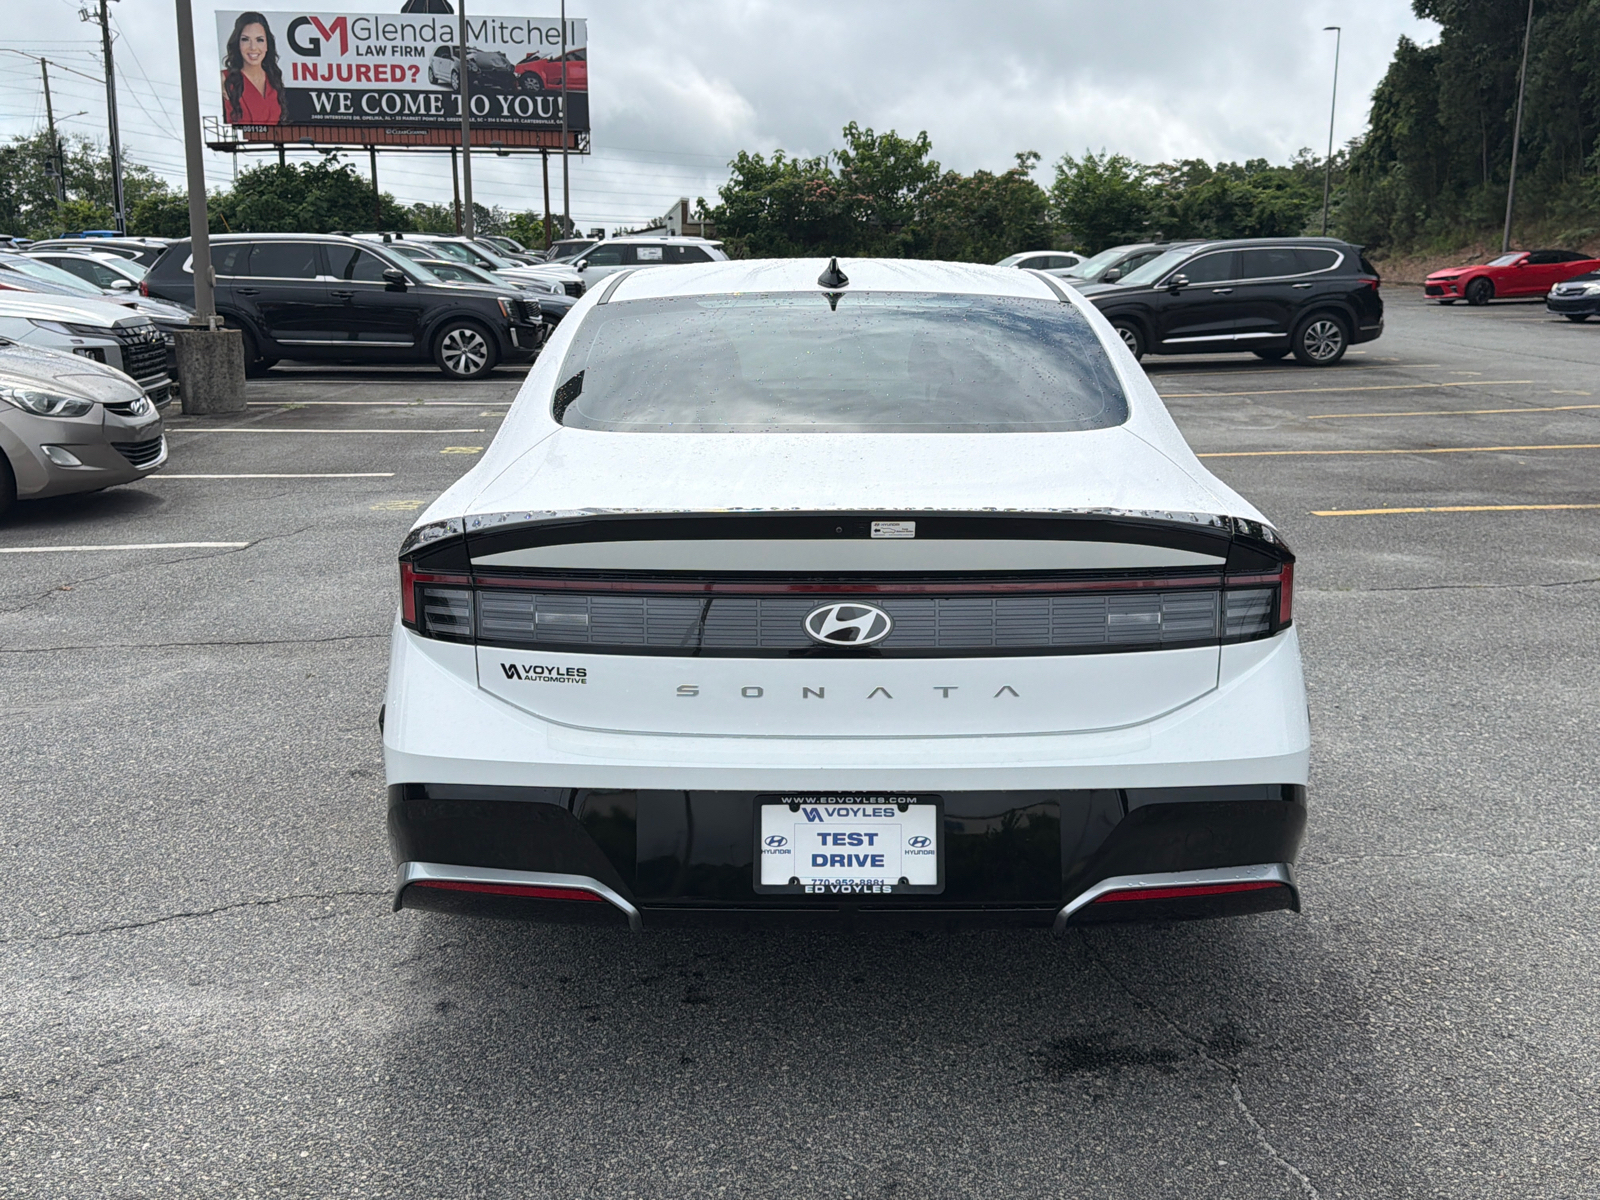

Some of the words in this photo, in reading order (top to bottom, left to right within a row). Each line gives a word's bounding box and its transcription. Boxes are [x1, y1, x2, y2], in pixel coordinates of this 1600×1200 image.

[351, 15, 454, 43] Glenda
[465, 19, 576, 46] Mitchell
[356, 45, 387, 57] LAW
[391, 46, 426, 58] FIRM
[292, 62, 421, 83] INJURED?
[309, 91, 354, 113] WE
[361, 92, 445, 115] COME
[496, 95, 564, 118] YOU!
[522, 664, 588, 678] VOYLES
[524, 675, 588, 684] AUTOMOTIVE
[676, 683, 1020, 699] SONATA
[824, 807, 895, 818] VOYLES
[817, 832, 879, 846] TEST
[811, 854, 885, 868] DRIVE
[805, 885, 826, 894] ED
[830, 885, 893, 894] VOYLES
